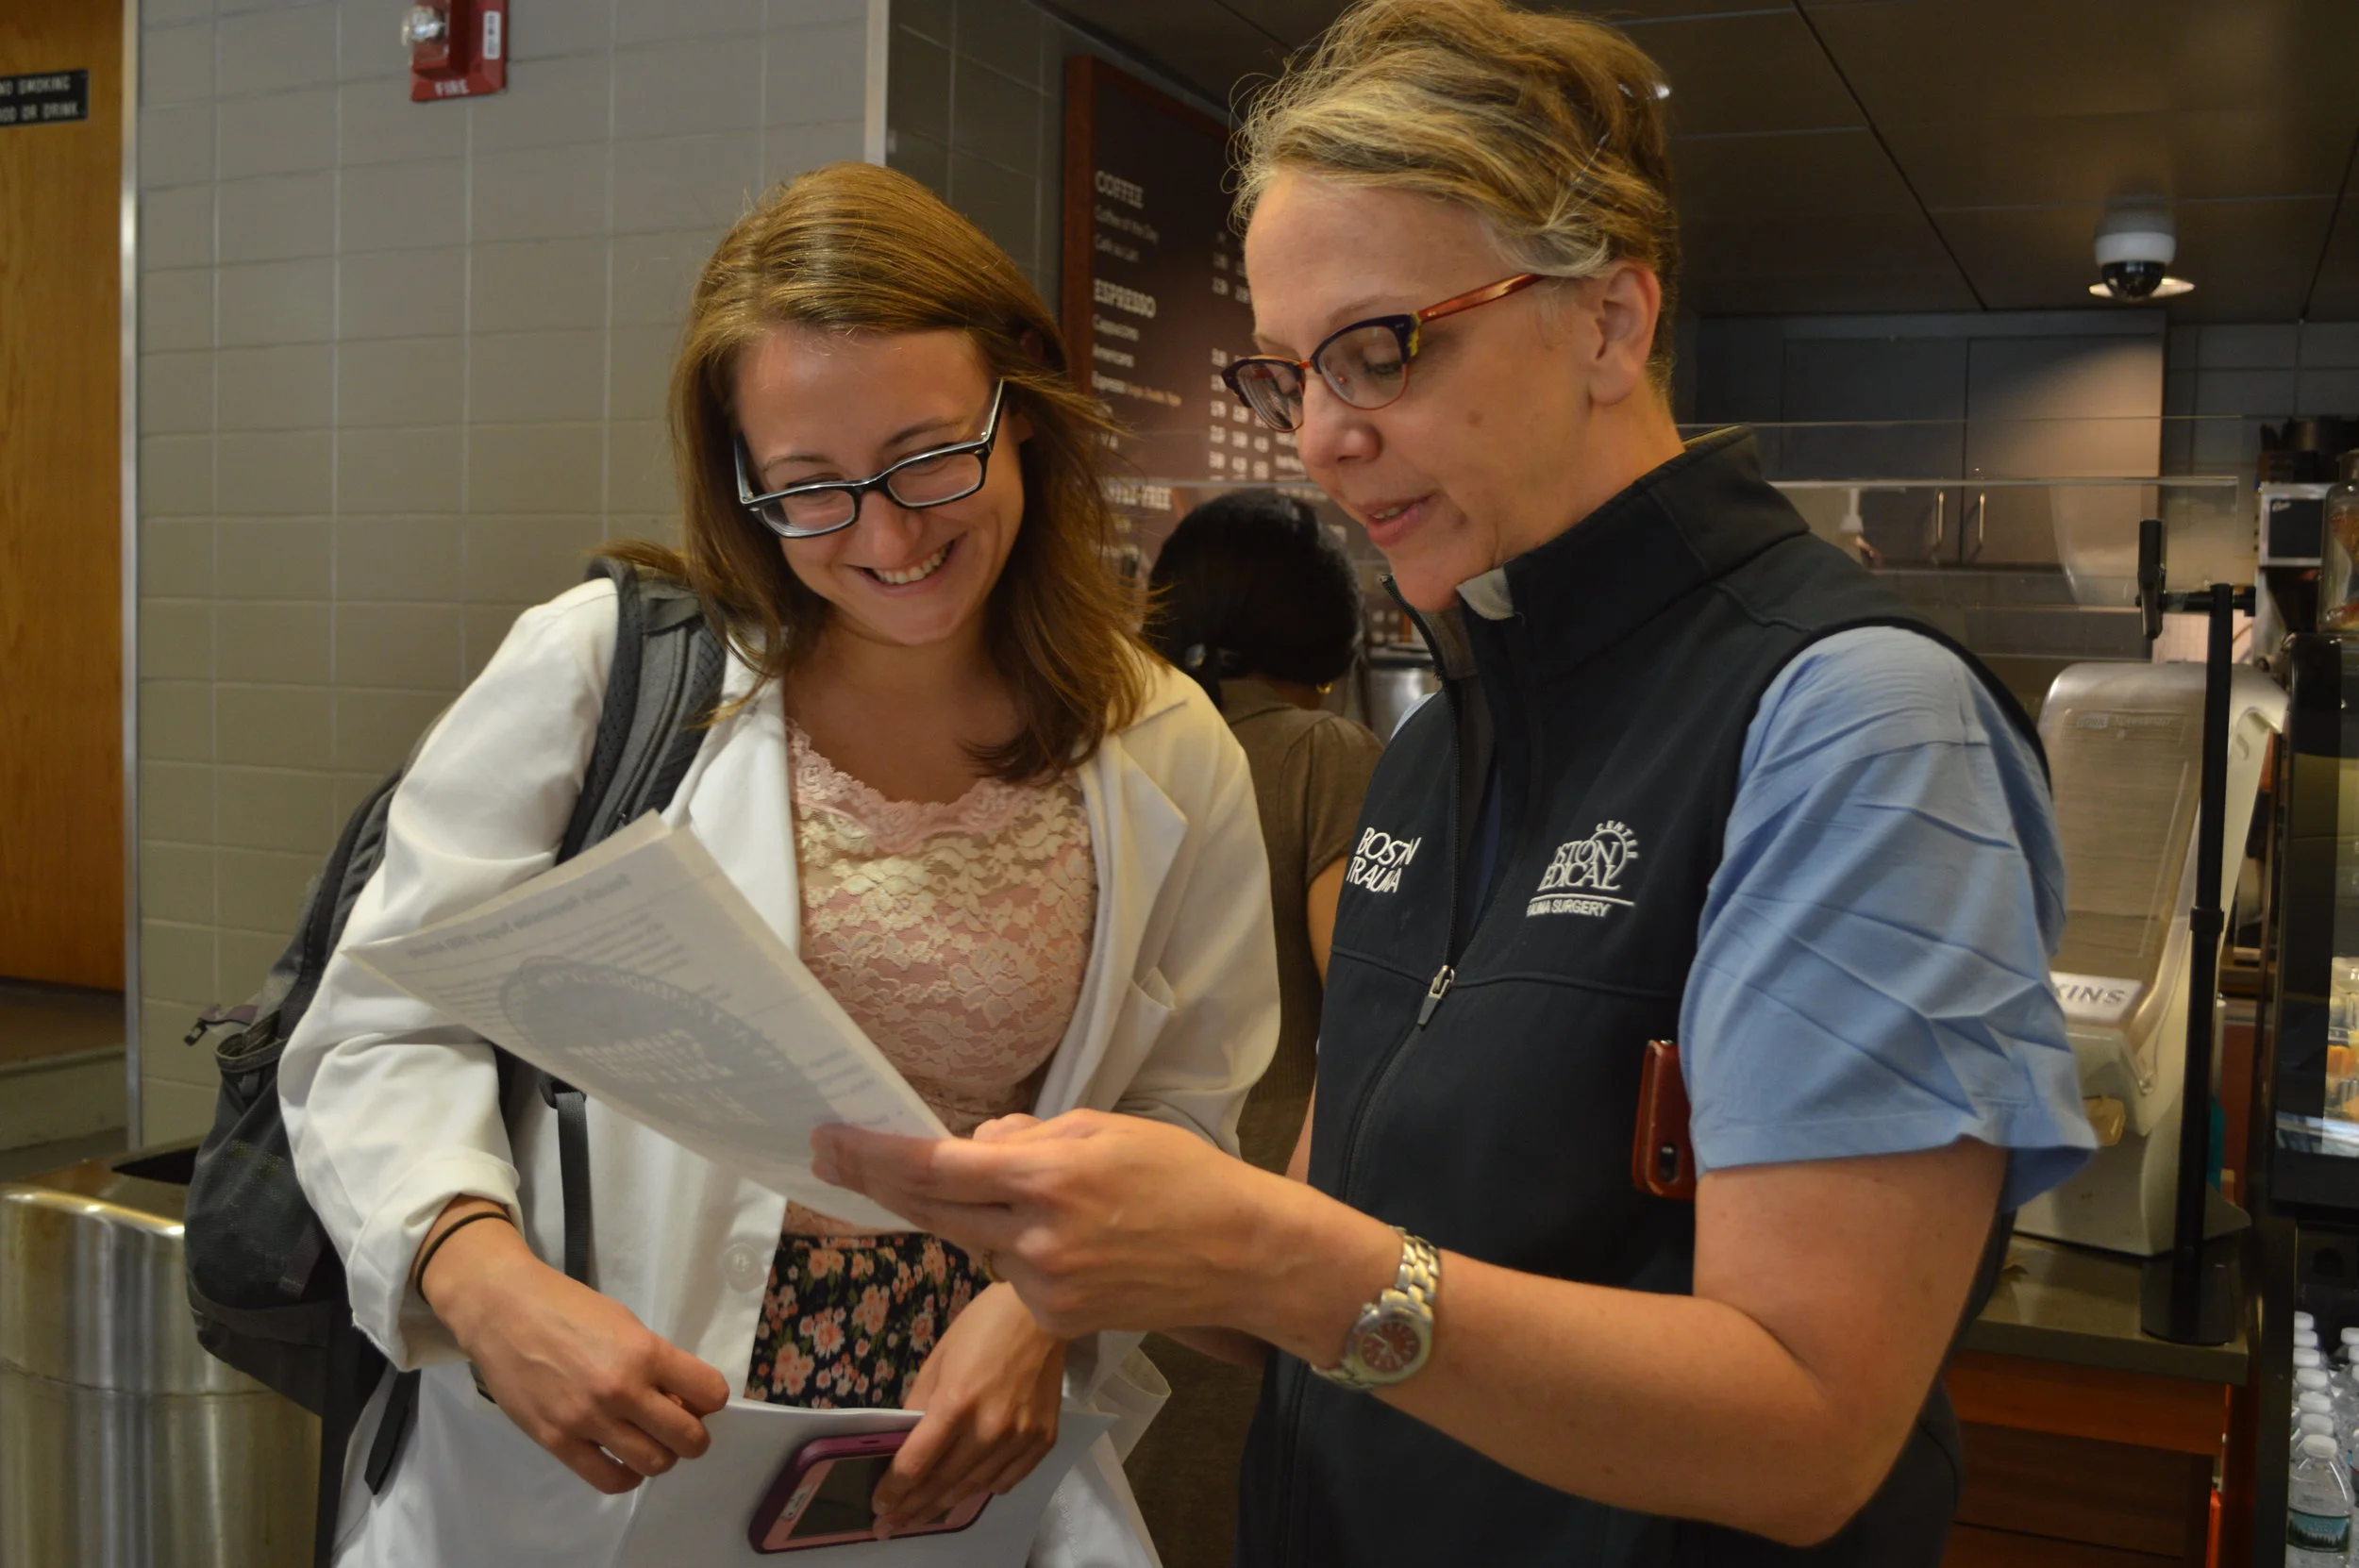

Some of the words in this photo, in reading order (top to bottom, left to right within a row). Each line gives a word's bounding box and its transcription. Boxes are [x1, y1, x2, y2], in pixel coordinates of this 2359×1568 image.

[435, 79, 470, 96] FIRE
[22, 104, 38, 122] OR
[42, 102, 78, 120] DRINK
[1095, 170, 1145, 209] COFFEE
[1093, 278, 1157, 319] ESPRESSO
[1536, 862, 1621, 892] EDICAL
[1551, 899, 1612, 917] SURGERY
